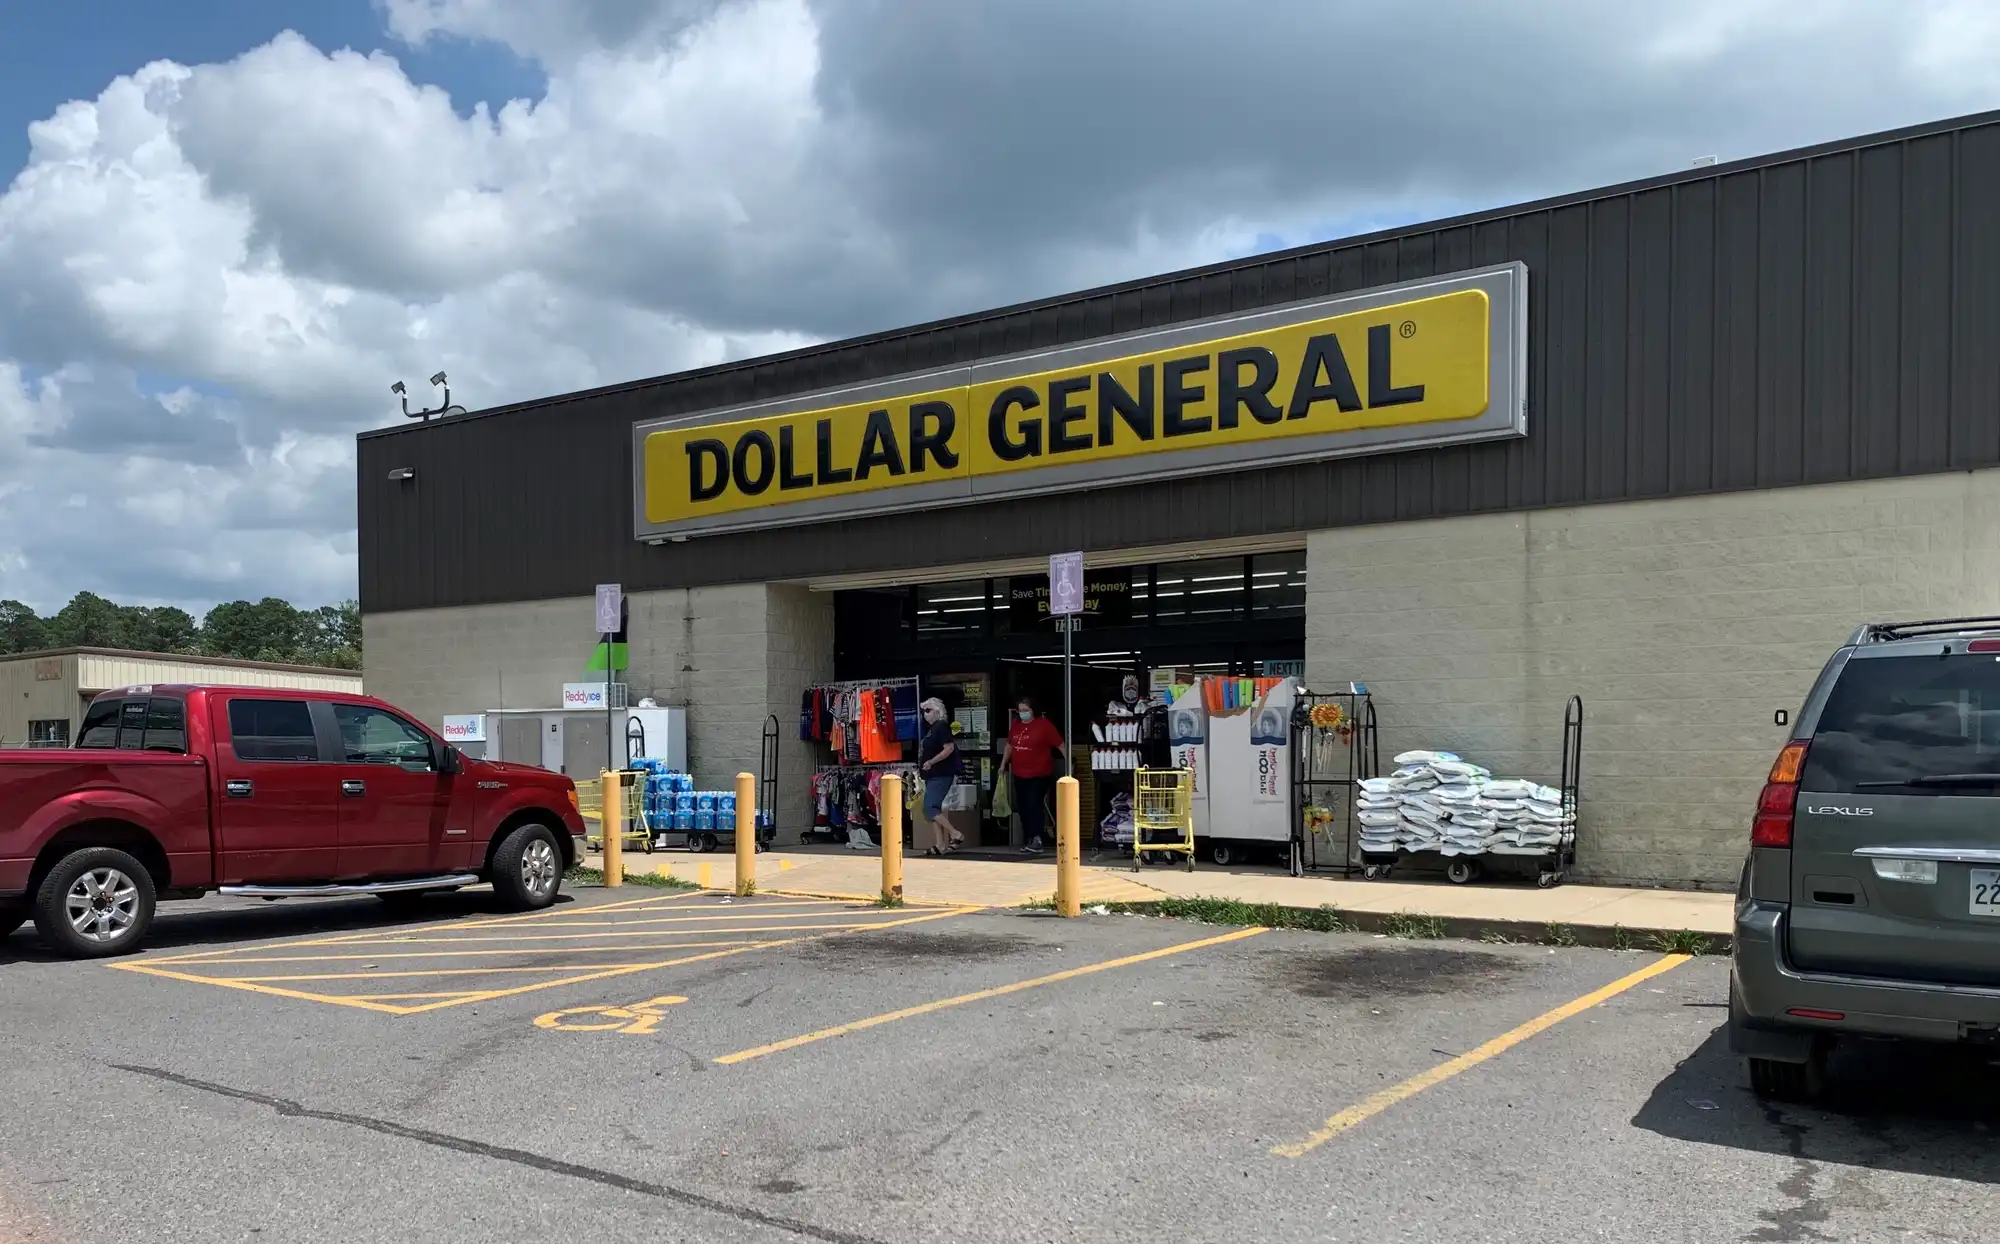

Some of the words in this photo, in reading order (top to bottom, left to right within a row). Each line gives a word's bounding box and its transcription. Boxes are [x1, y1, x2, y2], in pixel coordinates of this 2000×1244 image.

[685, 400, 960, 503] DOLLAR
[988, 323, 1425, 462] GENERAL
[1012, 589, 1034, 599] Save
[1090, 581, 1129, 593] Money.
[1269, 662, 1293, 676] NEXT
[1808, 806, 1874, 816] LEXUS
